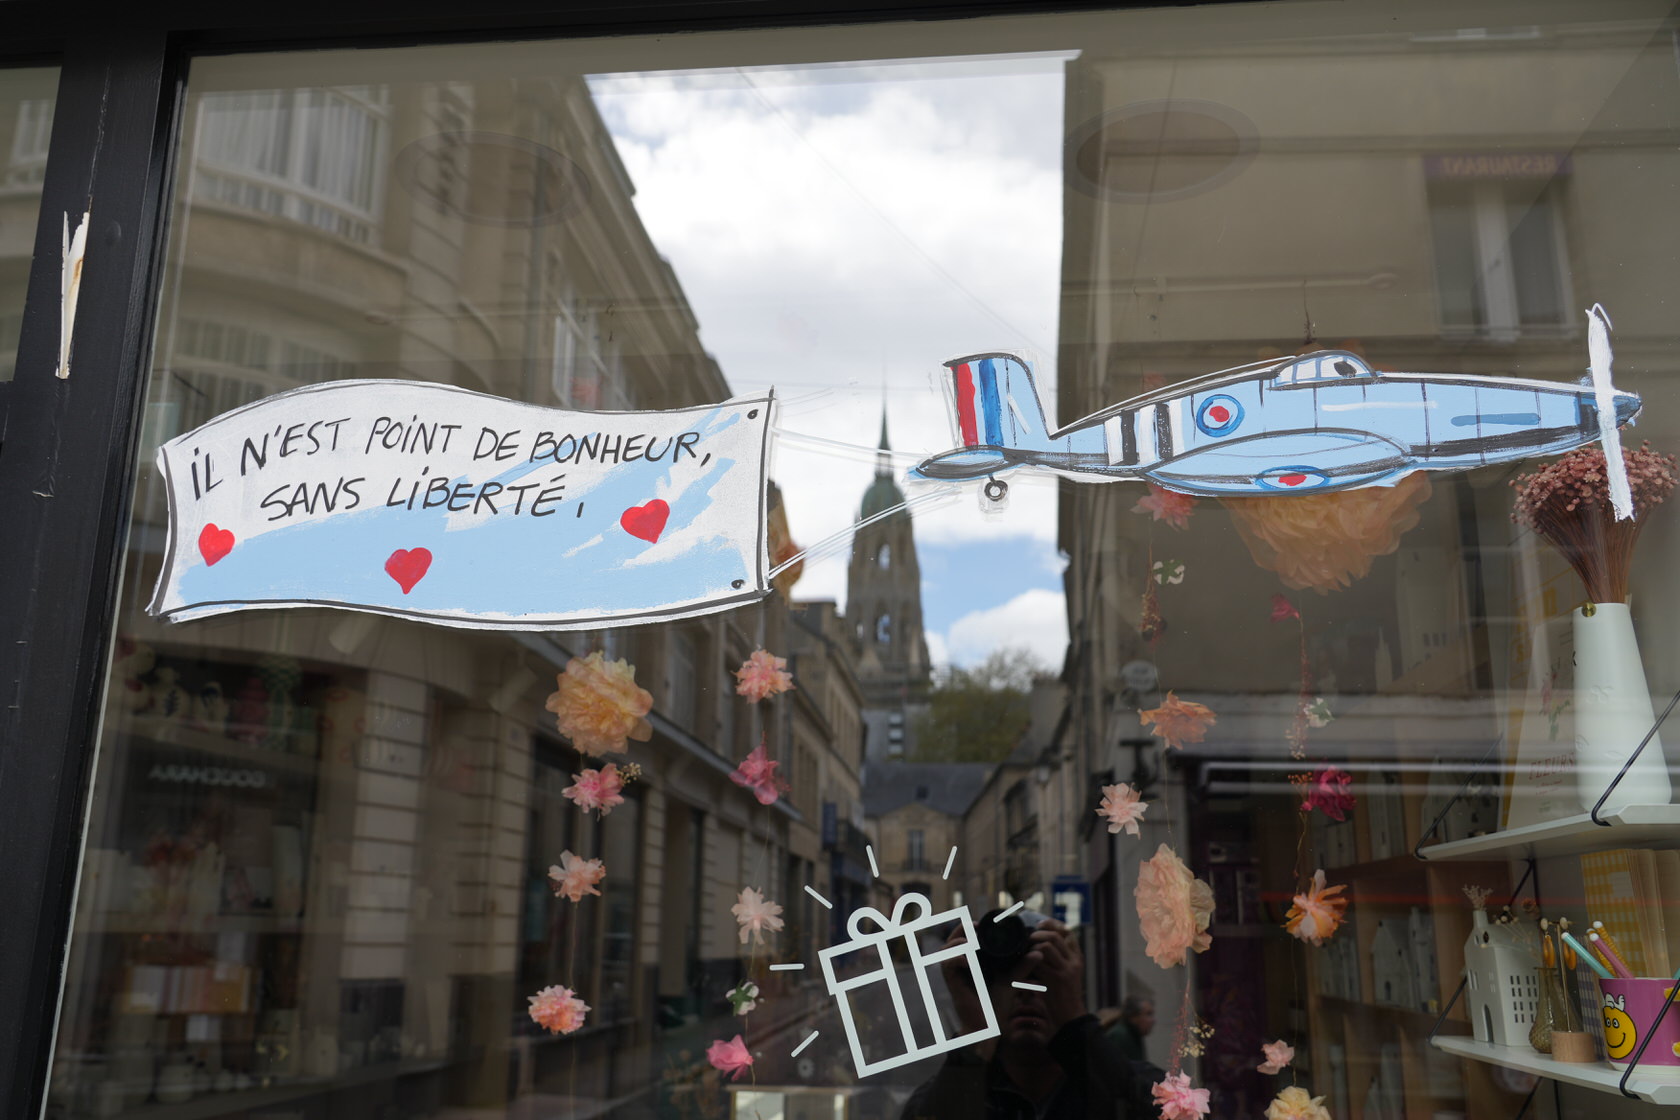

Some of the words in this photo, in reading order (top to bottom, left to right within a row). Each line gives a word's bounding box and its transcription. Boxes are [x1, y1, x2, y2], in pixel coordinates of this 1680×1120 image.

[240, 417, 352, 477] N'EST
[473, 426, 521, 461] DE
[529, 431, 711, 467] BONHEUR,
[260, 476, 366, 522] SANS
[1528, 751, 1575, 781] FLEURS
